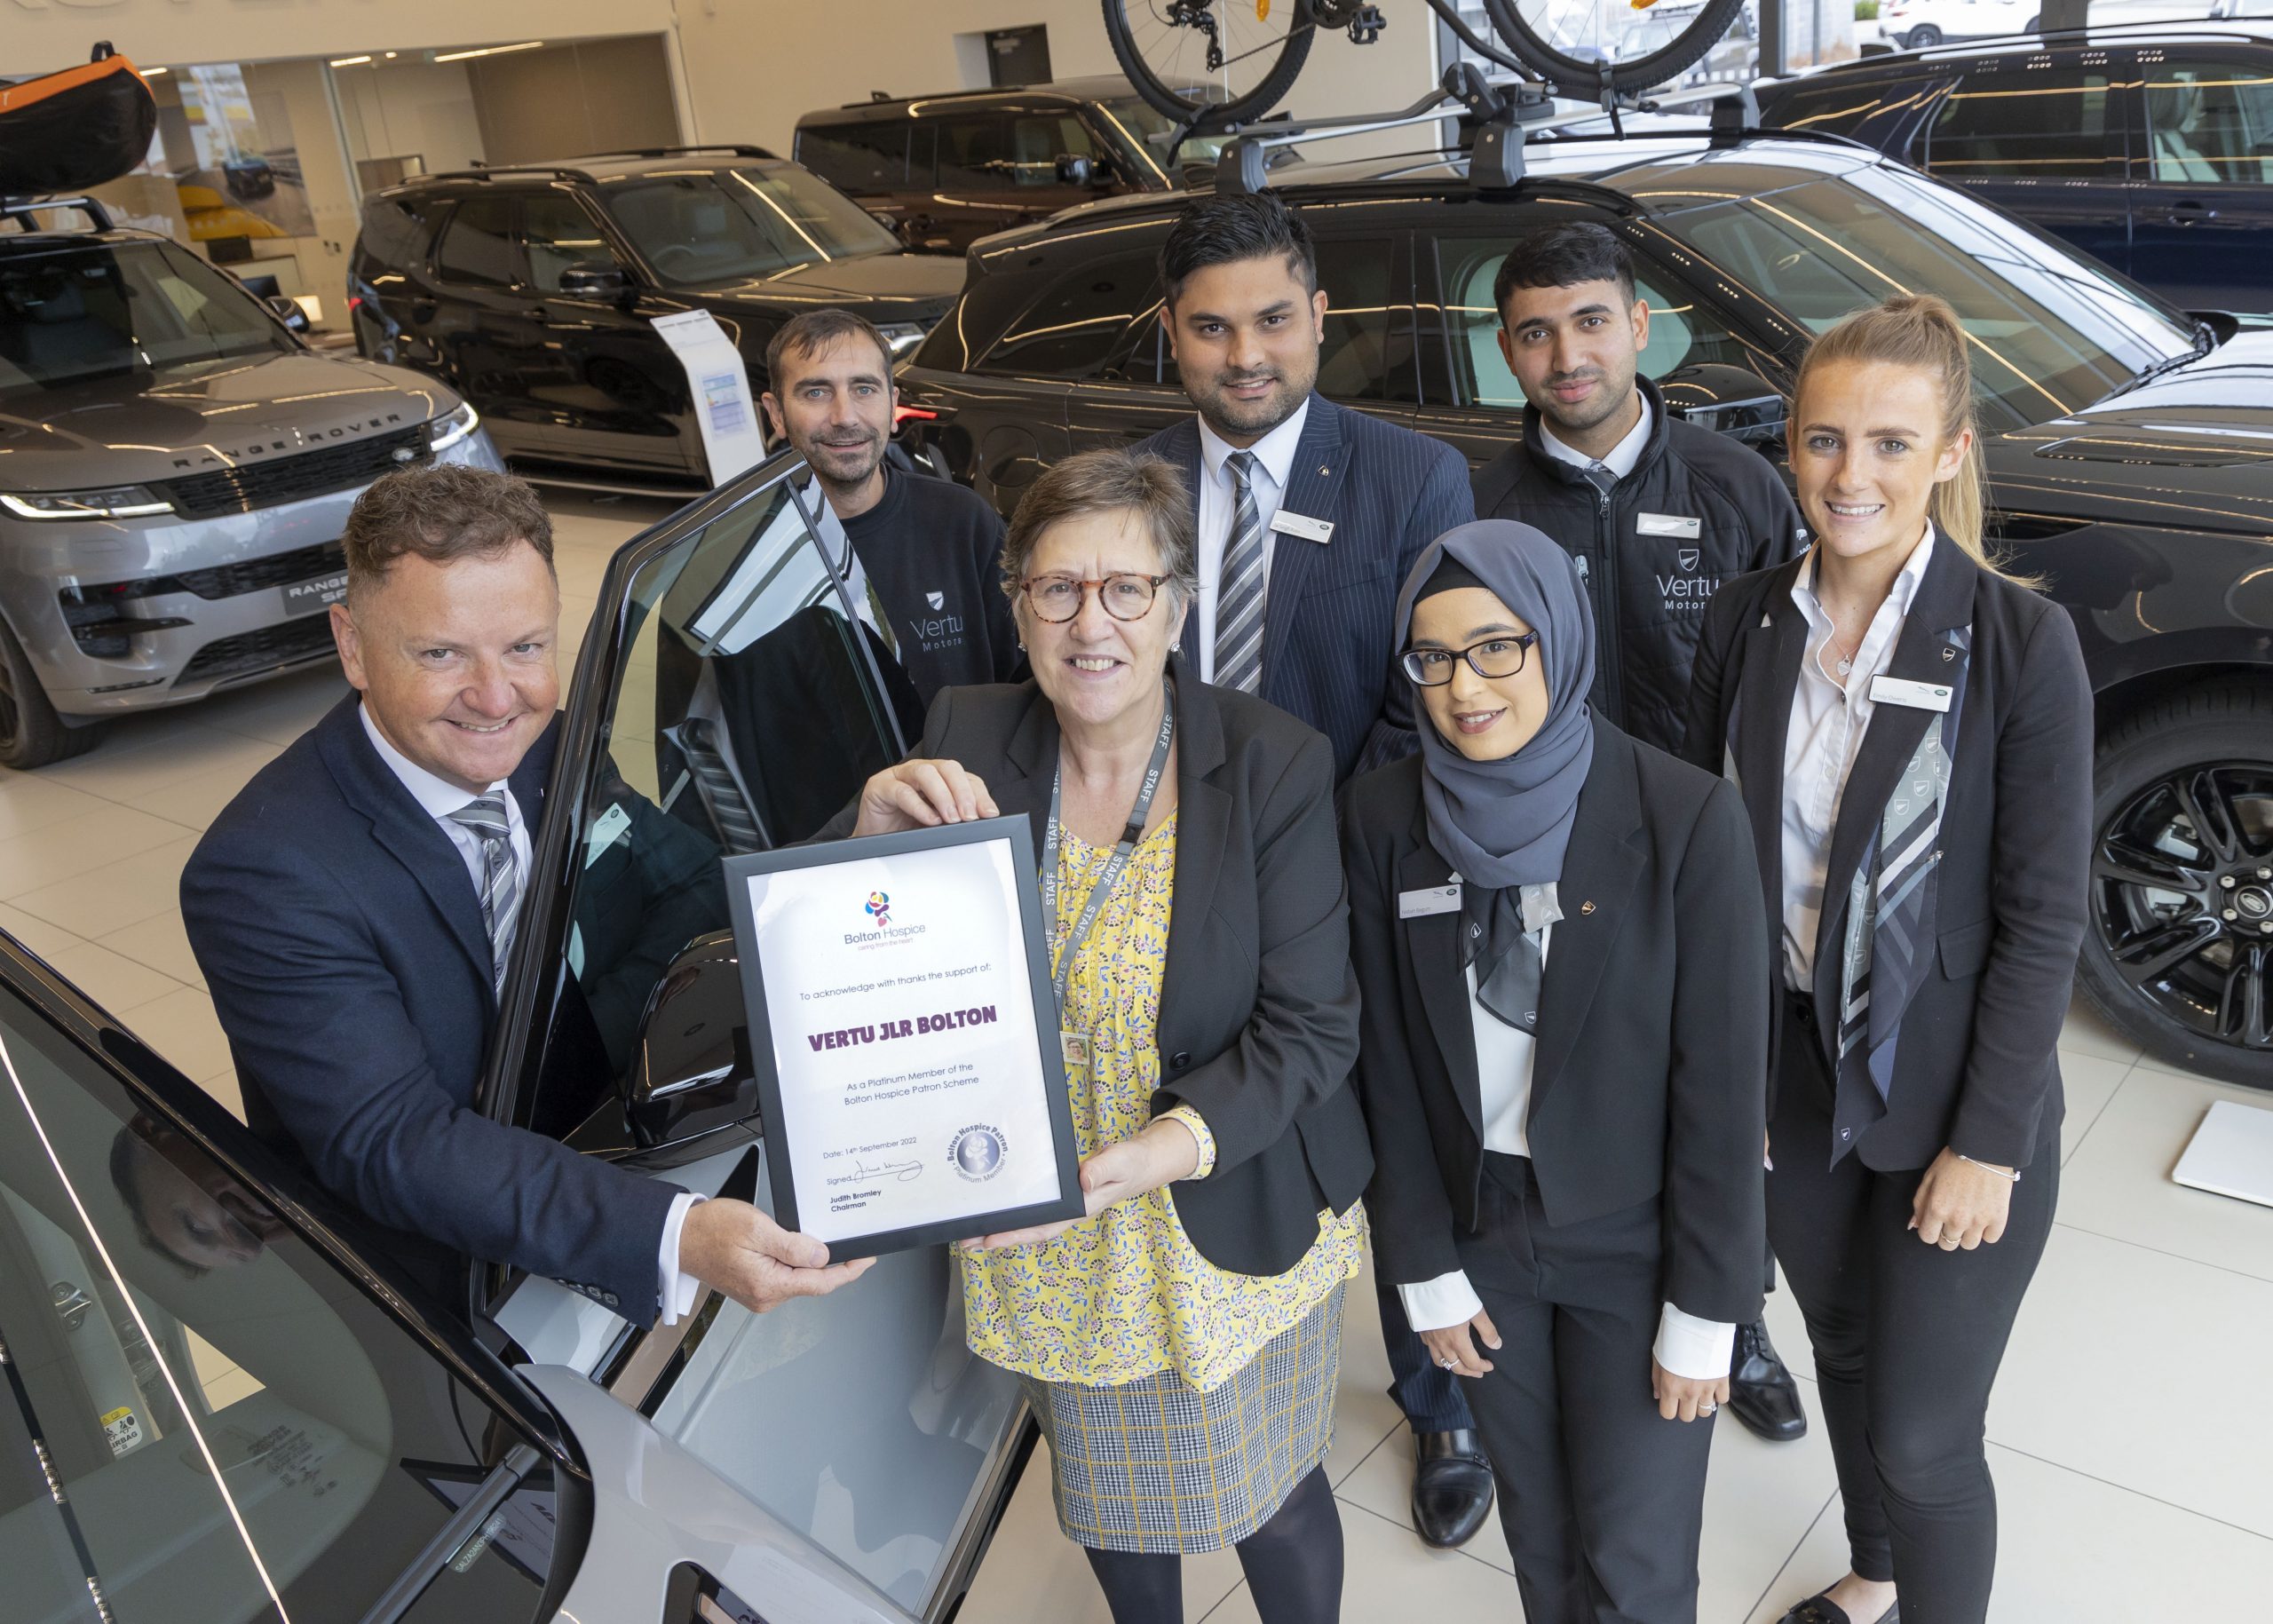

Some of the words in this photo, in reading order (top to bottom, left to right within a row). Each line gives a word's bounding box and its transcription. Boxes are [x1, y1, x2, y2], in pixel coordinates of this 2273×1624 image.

[172, 441, 286, 468] RANGE
[307, 414, 401, 442] ROVER
[289, 575, 349, 598] RANGE
[1656, 575, 1720, 597] Vertu
[1665, 600, 1706, 610] Motor
[910, 614, 963, 639] Vertu
[923, 638, 962, 653] Motors
[1160, 714, 1173, 749] STAFF
[1140, 769, 1159, 804] STAFF
[1048, 816, 1058, 850] STAFF
[1102, 855, 1123, 887] STAFF
[1045, 872, 1057, 906] STAFF
[844, 931, 882, 945] Bolton
[883, 924, 926, 939] Hospice
[1074, 905, 1096, 939] STAFF
[812, 982, 875, 1000] acknowledge
[877, 978, 896, 988] with
[897, 974, 926, 986] thanks
[928, 971, 943, 980] the
[945, 965, 978, 978] support
[1053, 962, 1068, 998] STAFF
[807, 1025, 875, 1052] VERTU
[879, 1019, 914, 1042] JLR
[916, 1005, 997, 1034] BOLTON
[867, 1075, 907, 1088] Platinum
[907, 1067, 946, 1081] Member
[947, 1065, 957, 1073] of
[959, 1063, 974, 1072] the
[844, 1094, 873, 1105] Bolton
[874, 1089, 910, 1101] Hospice
[912, 1082, 941, 1094] Patron
[943, 1076, 979, 1089] Scheme
[823, 1151, 843, 1160] Date:
[859, 1139, 899, 1153] September
[899, 1137, 917, 1146] 2022
[946, 1135, 962, 1161] Bolton
[958, 1122, 991, 1137] Hospice
[991, 1127, 1009, 1152] Patron
[827, 1175, 852, 1186] Signed
[954, 1166, 982, 1184] Platinum
[983, 1158, 1006, 1182] Member
[829, 1194, 851, 1204] Judith
[852, 1189, 882, 1200] Bromley
[831, 1201, 867, 1212] Chairman
[112, 1431, 138, 1448] IRBAG
